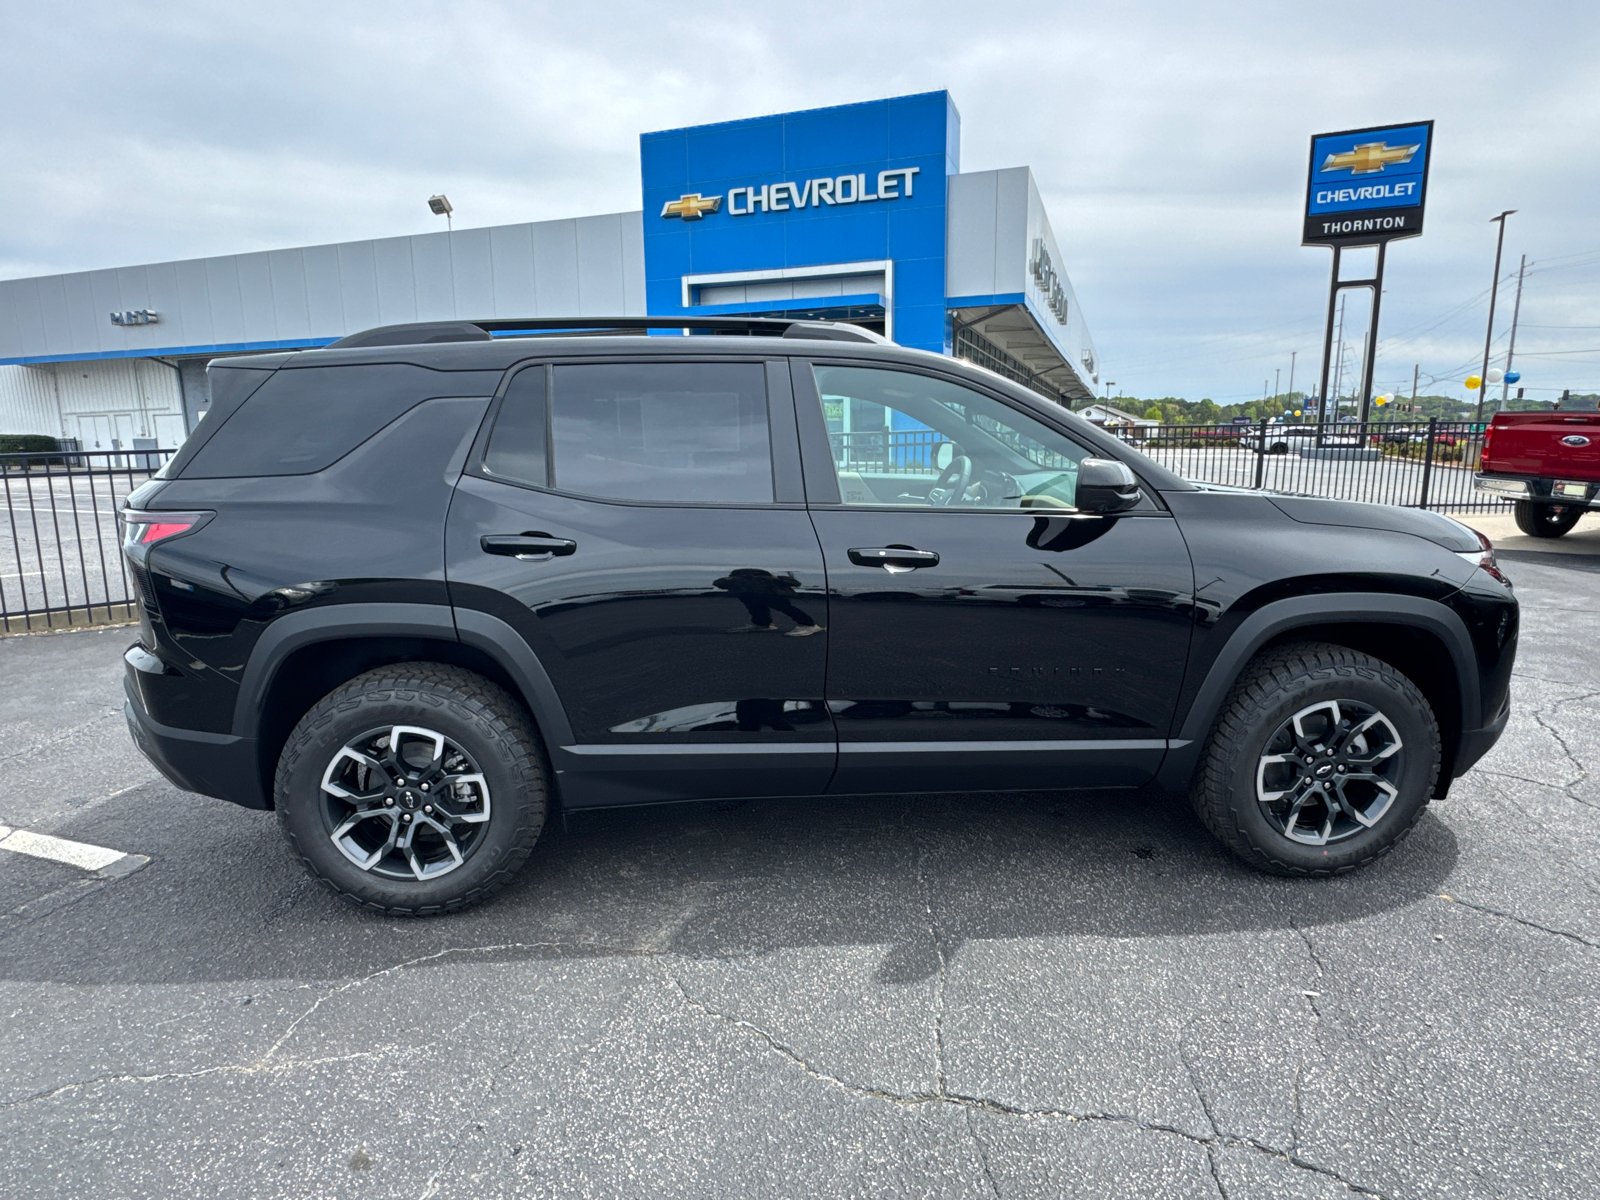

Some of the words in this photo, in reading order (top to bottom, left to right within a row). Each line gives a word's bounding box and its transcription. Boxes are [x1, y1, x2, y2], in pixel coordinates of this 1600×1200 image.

[728, 167, 920, 216] CHEVROLET
[1316, 182, 1416, 204] CHEVROLET
[1322, 216, 1405, 234] THORNTON
